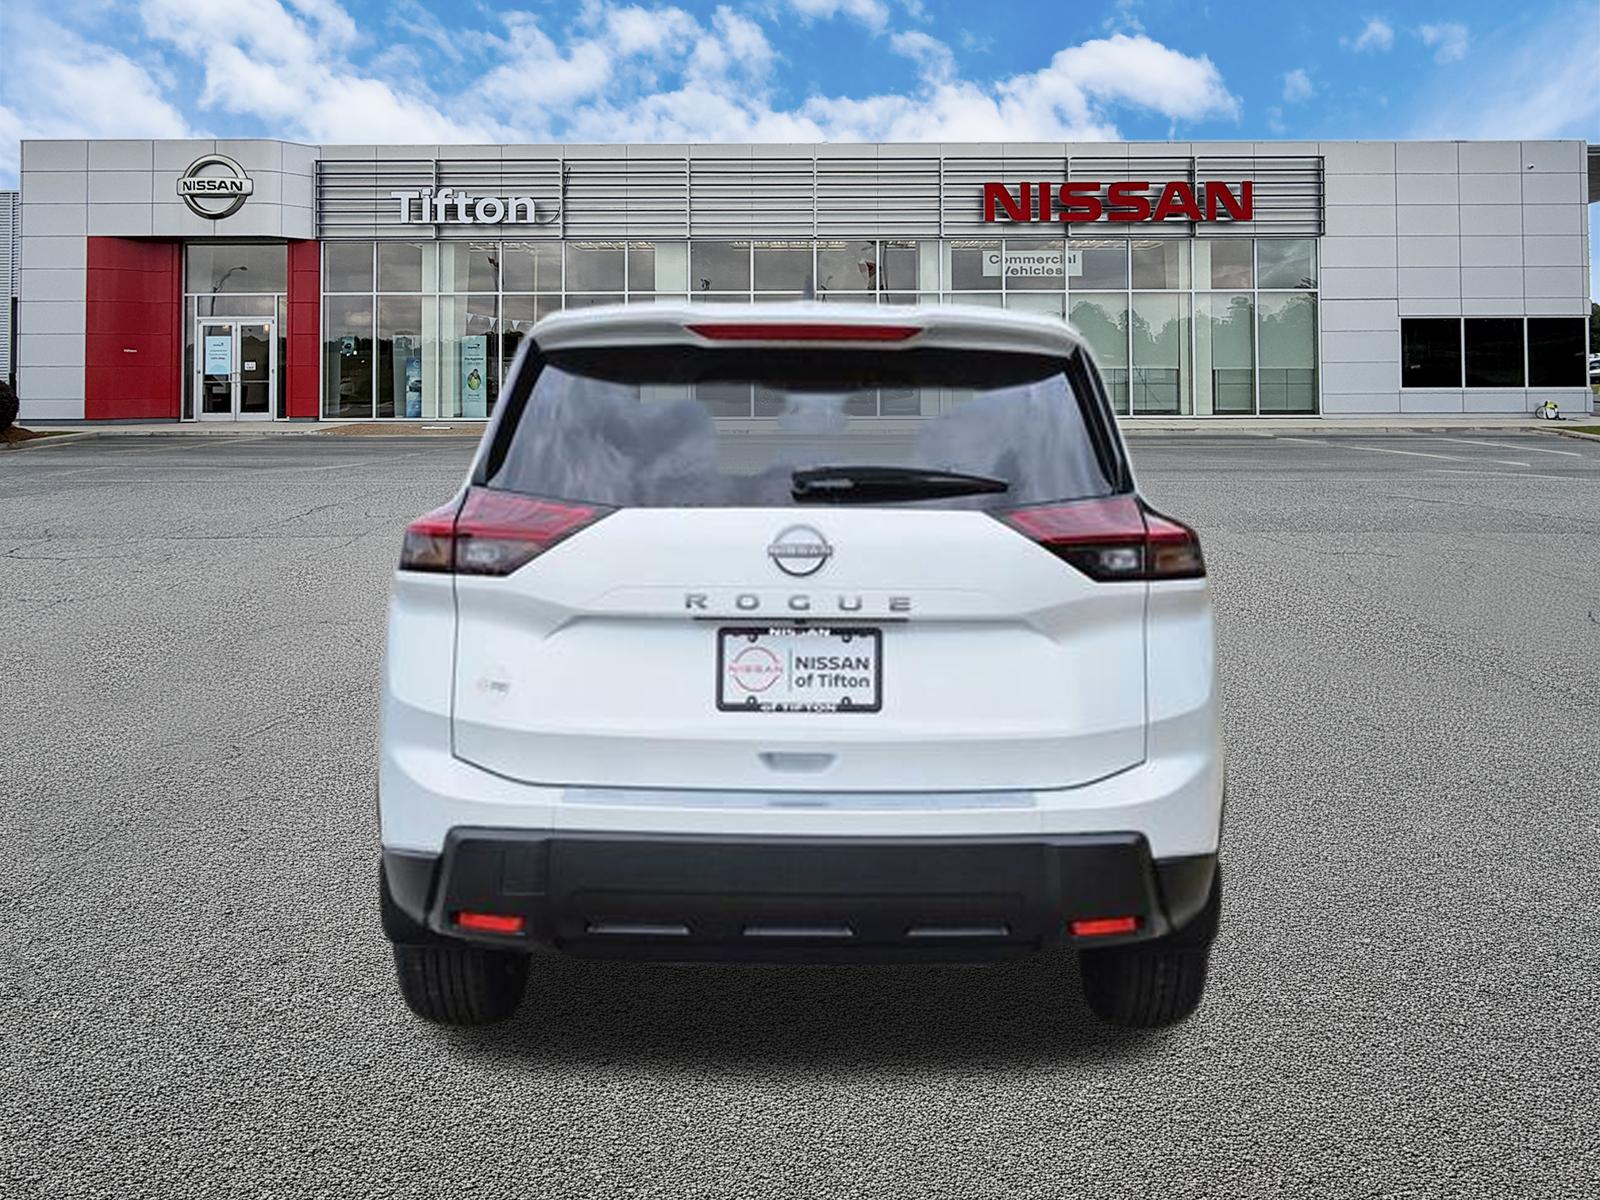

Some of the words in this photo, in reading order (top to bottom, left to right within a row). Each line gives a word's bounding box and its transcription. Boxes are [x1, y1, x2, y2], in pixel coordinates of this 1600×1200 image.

[182, 180, 243, 191] NISSAN
[391, 188, 537, 224] Tifton
[983, 181, 1254, 222] NISSAN
[684, 593, 912, 612] ROGUE
[768, 627, 831, 636] NISAN
[794, 656, 870, 671] NISSAN
[794, 673, 813, 688] of
[818, 673, 871, 688] Tifton
